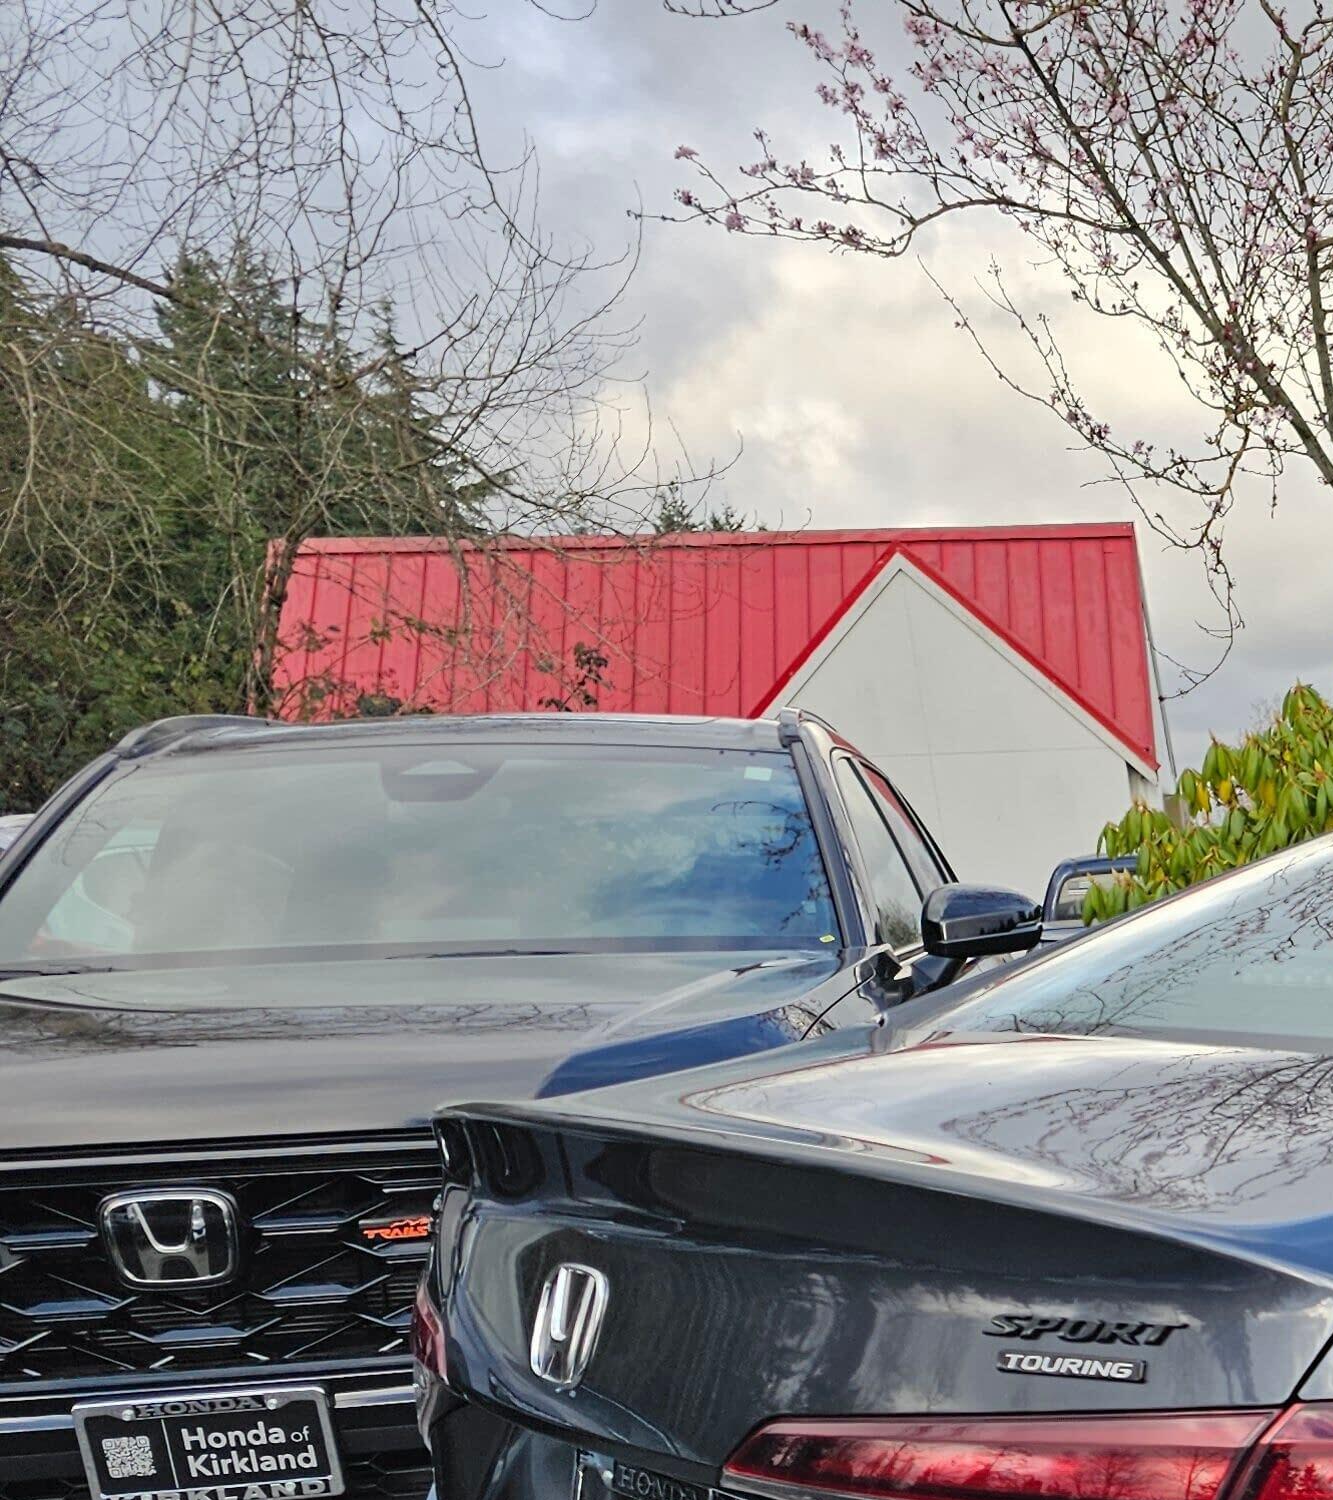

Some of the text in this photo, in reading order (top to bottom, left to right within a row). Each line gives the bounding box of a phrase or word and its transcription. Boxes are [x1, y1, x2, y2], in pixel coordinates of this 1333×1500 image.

[982, 1314, 1190, 1346] SPORT
[1004, 1353, 1134, 1379] TOURING
[137, 1396, 262, 1418] HONDA
[180, 1421, 309, 1451] Honda of
[187, 1445, 318, 1478] Kirkland
